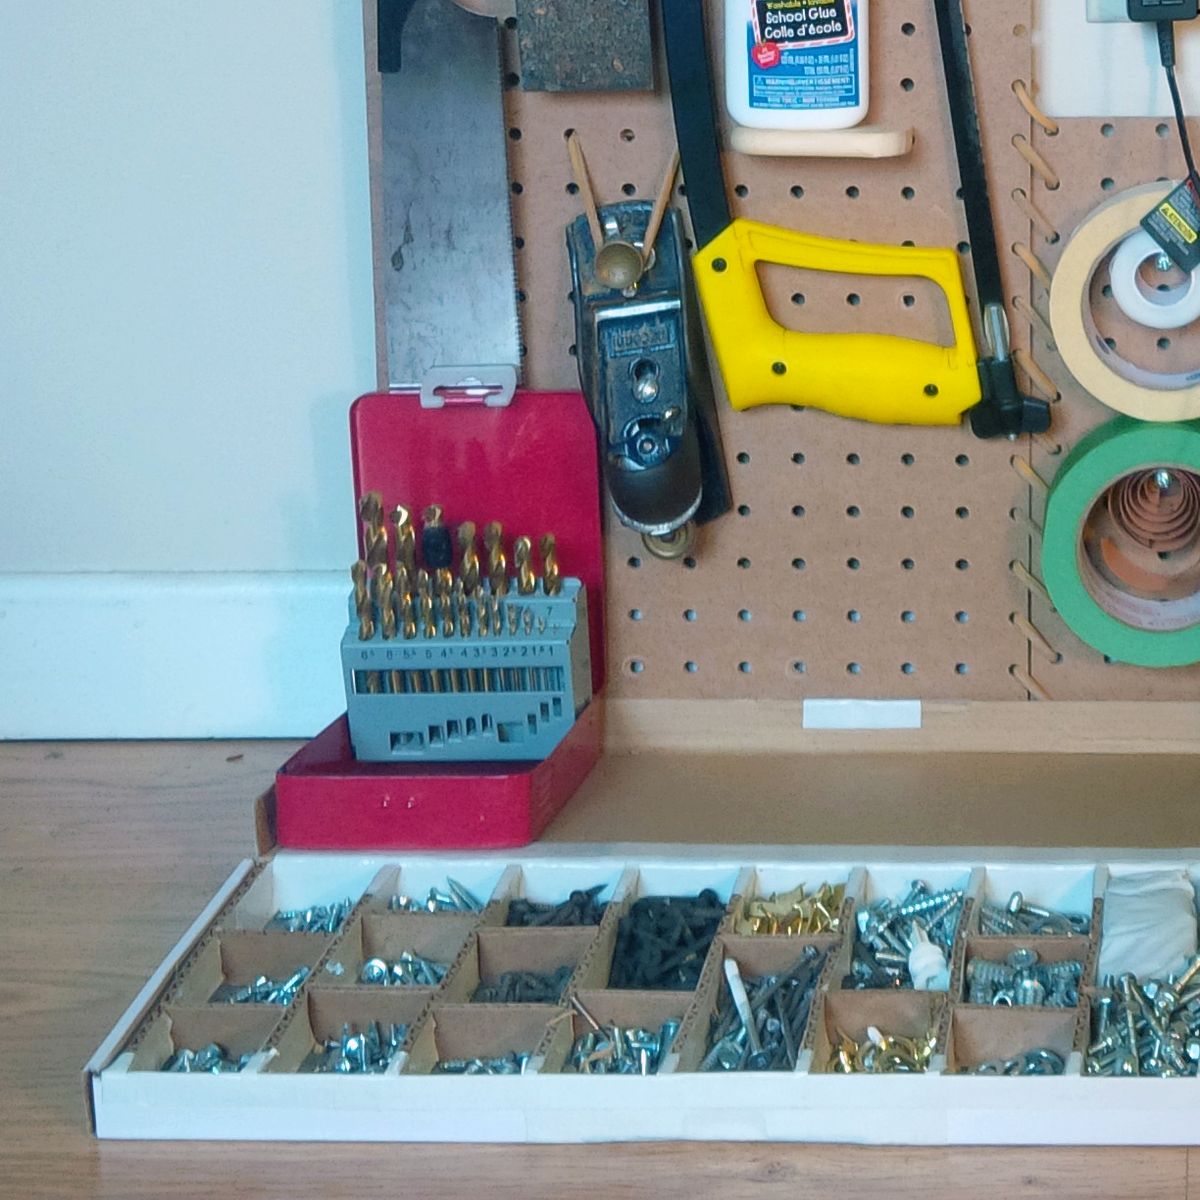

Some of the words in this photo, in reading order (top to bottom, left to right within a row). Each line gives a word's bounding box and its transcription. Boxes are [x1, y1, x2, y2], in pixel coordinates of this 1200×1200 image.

[766, 8, 806, 25] School
[808, 6, 837, 20] Glue
[765, 25, 795, 40] Colle
[797, 20, 842, 37] d'école
